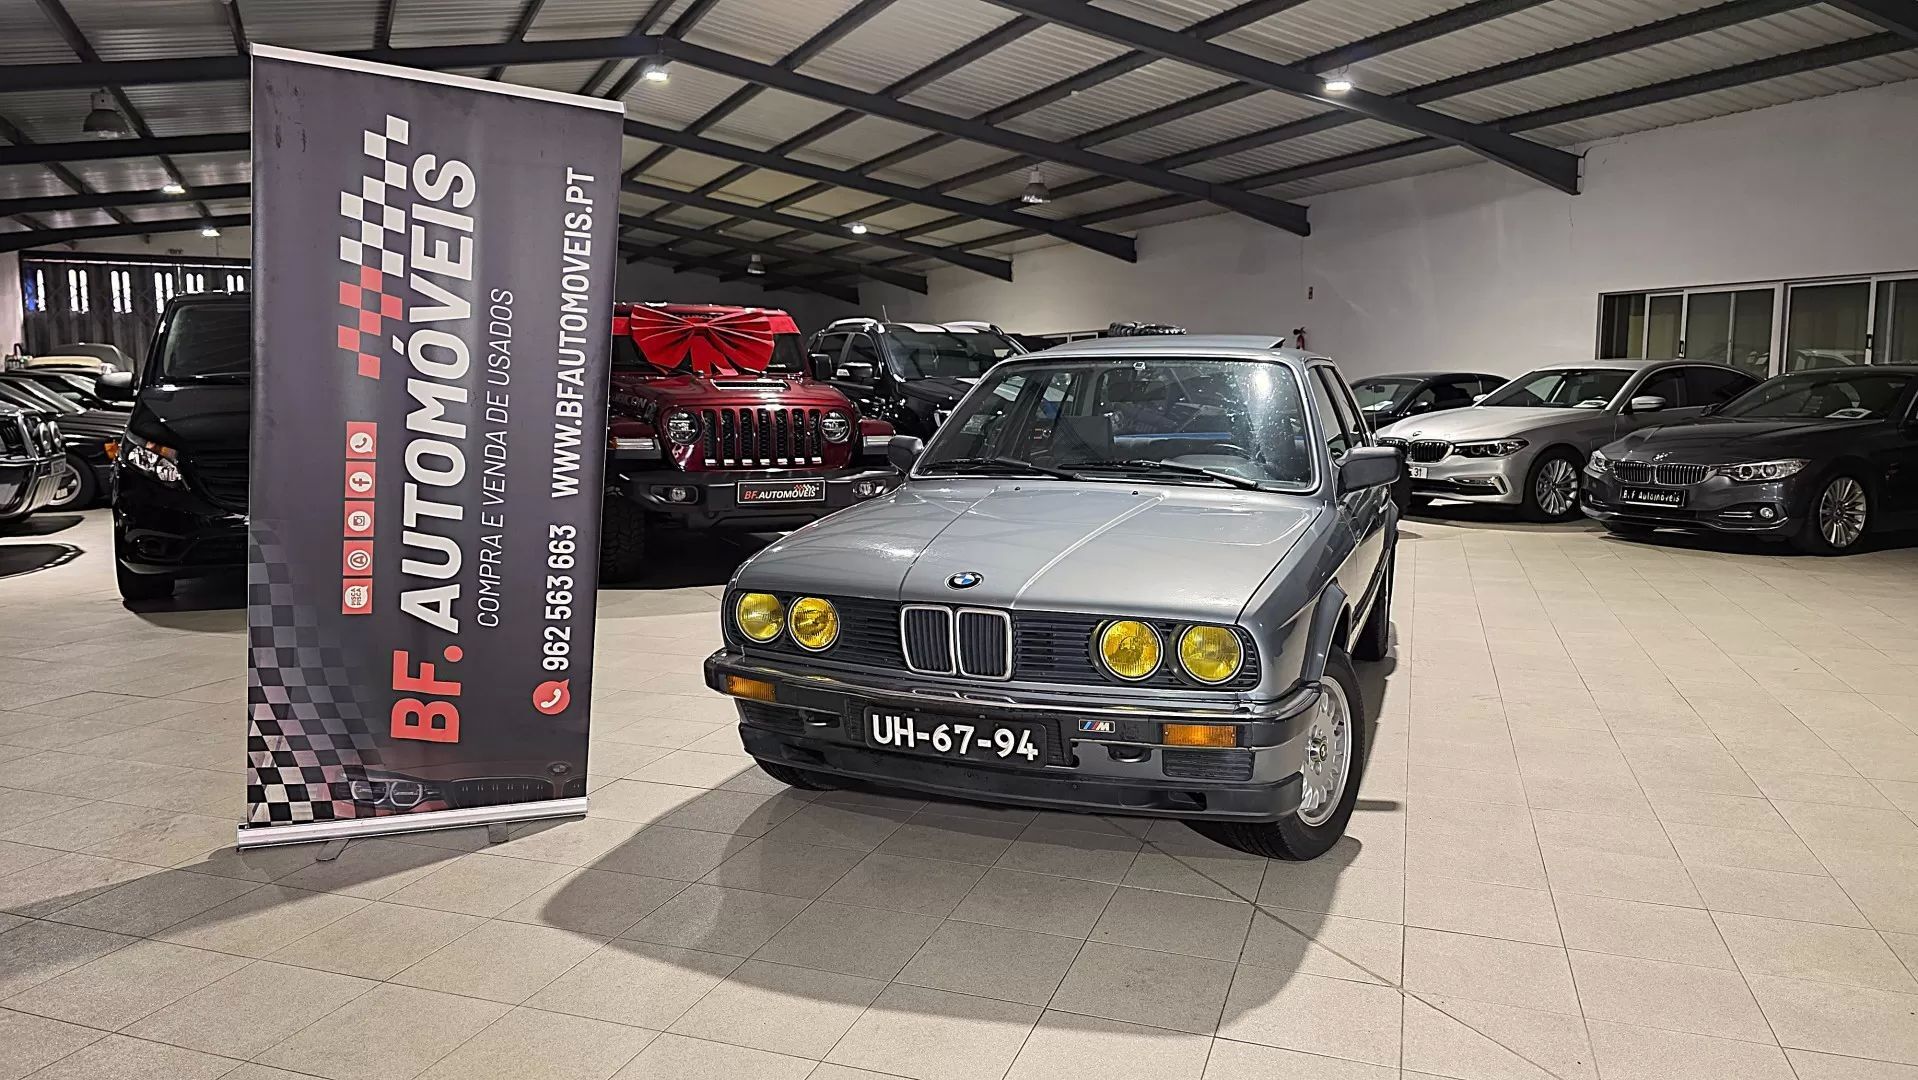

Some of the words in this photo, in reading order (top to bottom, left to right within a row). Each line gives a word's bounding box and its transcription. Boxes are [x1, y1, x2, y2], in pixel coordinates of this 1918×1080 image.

[488, 288, 514, 386] USADOS
[551, 167, 595, 498] WWW.BFAUTOMOVEIS.PT
[485, 391, 509, 424] DE
[483, 430, 507, 507] VENDA
[482, 513, 505, 529] E
[548, 524, 577, 569] 663
[477, 534, 502, 627] COMPRA
[545, 575, 574, 621] 563
[542, 626, 571, 671] 962
[872, 714, 1039, 761] UH-67-94
